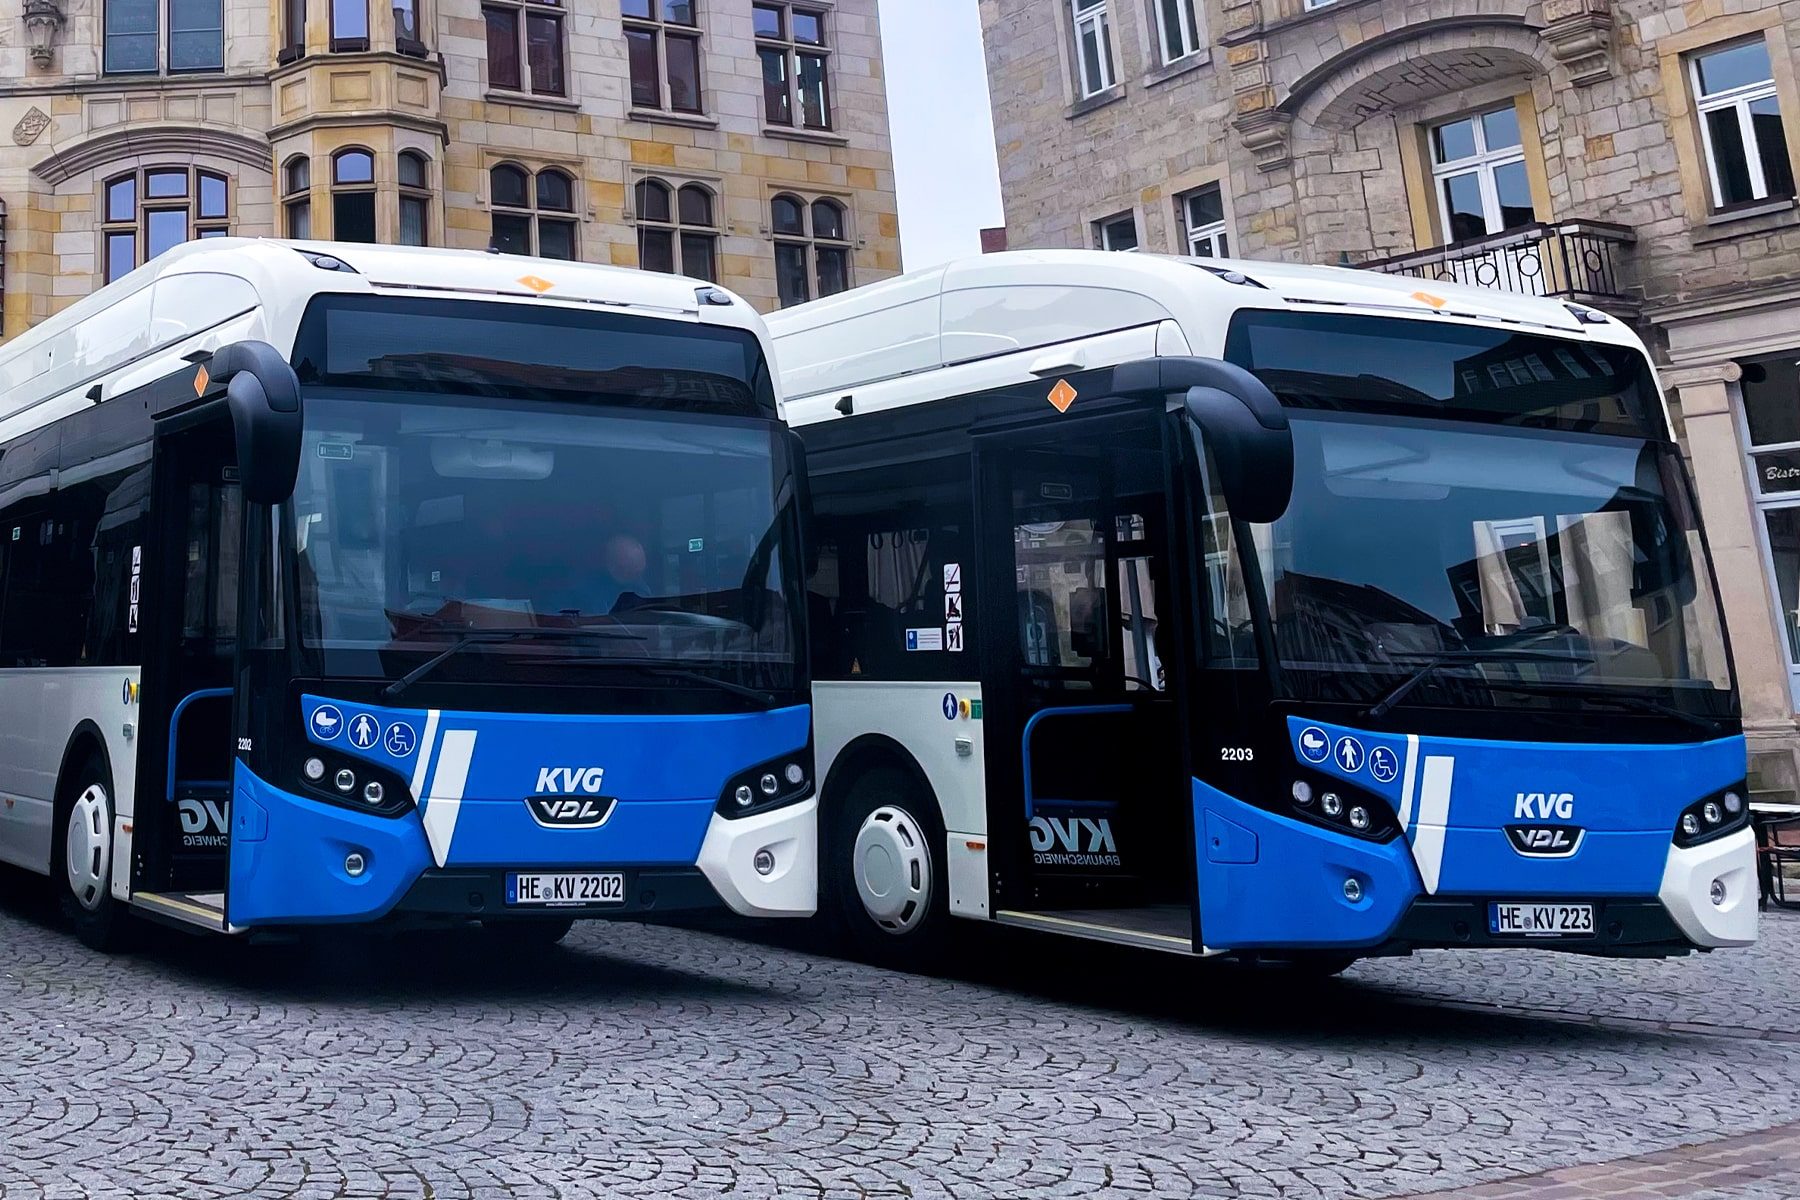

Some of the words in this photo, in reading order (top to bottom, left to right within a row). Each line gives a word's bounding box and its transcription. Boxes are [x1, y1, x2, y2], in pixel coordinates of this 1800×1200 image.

[238, 737, 252, 751] 2202
[1221, 747, 1254, 761] 2203
[535, 767, 604, 793] KVG
[540, 800, 600, 819] VDL
[1514, 793, 1574, 819] KVG
[1516, 829, 1570, 848] VDL
[519, 877, 541, 899] HE
[554, 877, 576, 899] KV
[580, 876, 621, 899] 2202
[1500, 907, 1522, 929] HE
[1533, 907, 1556, 930] KV
[1560, 907, 1592, 930] 223
